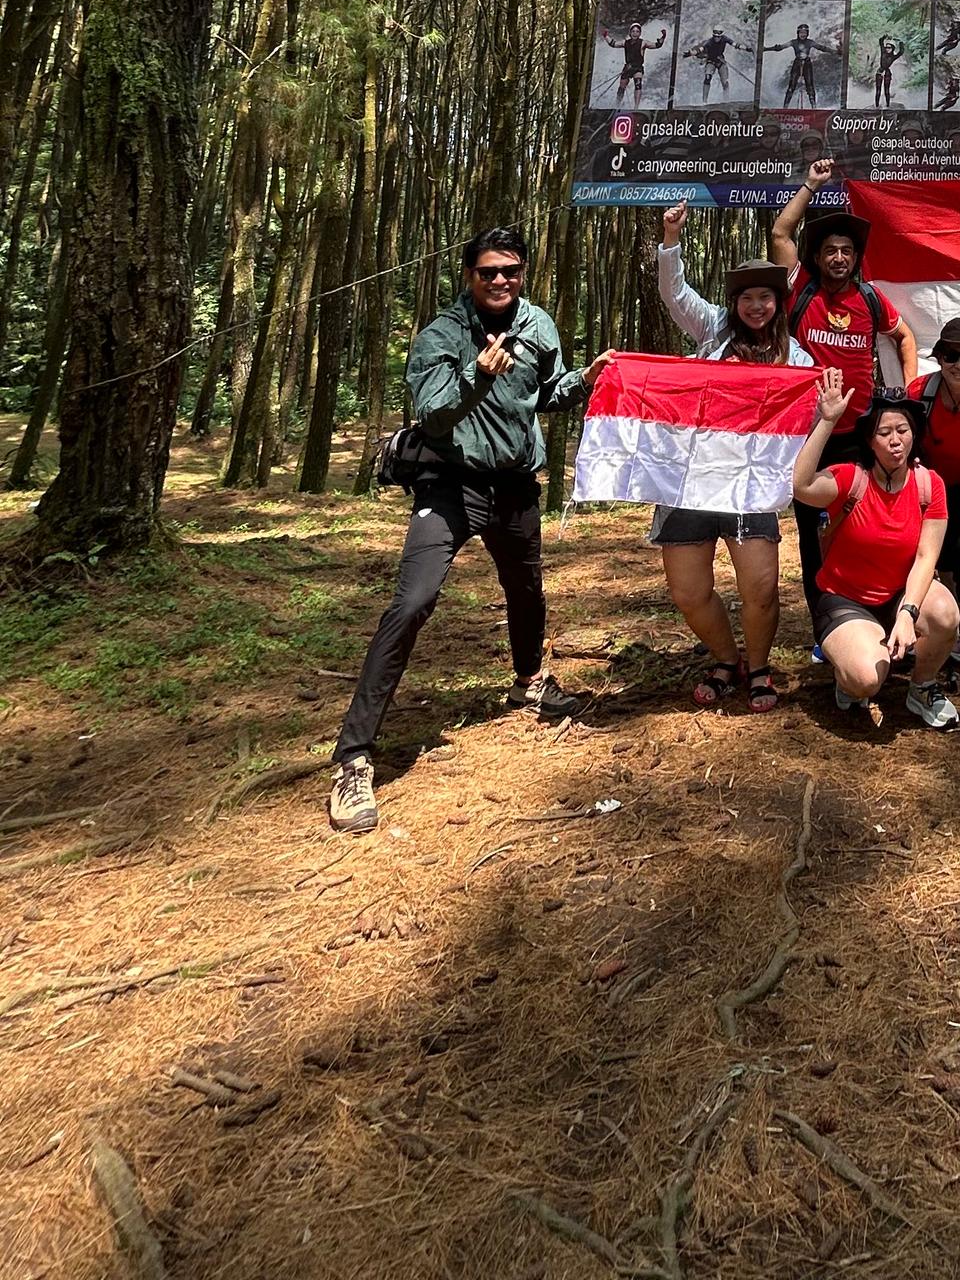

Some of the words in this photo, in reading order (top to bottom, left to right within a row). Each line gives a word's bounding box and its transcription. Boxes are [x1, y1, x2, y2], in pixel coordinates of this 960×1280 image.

[642, 119, 764, 140] gnsalak_adventure
[831, 115, 877, 133] Support
[878, 116, 894, 134] by
[871, 136, 954, 151] @sapala_outdoor
[637, 157, 793, 178] canyoneering_curugtebing
[870, 152, 920, 168] @Langkah
[572, 186, 612, 200] ADMIN
[619, 186, 697, 201] 085773463640
[729, 189, 767, 204] ELVINA
[807, 328, 867, 348] INDONESIA
